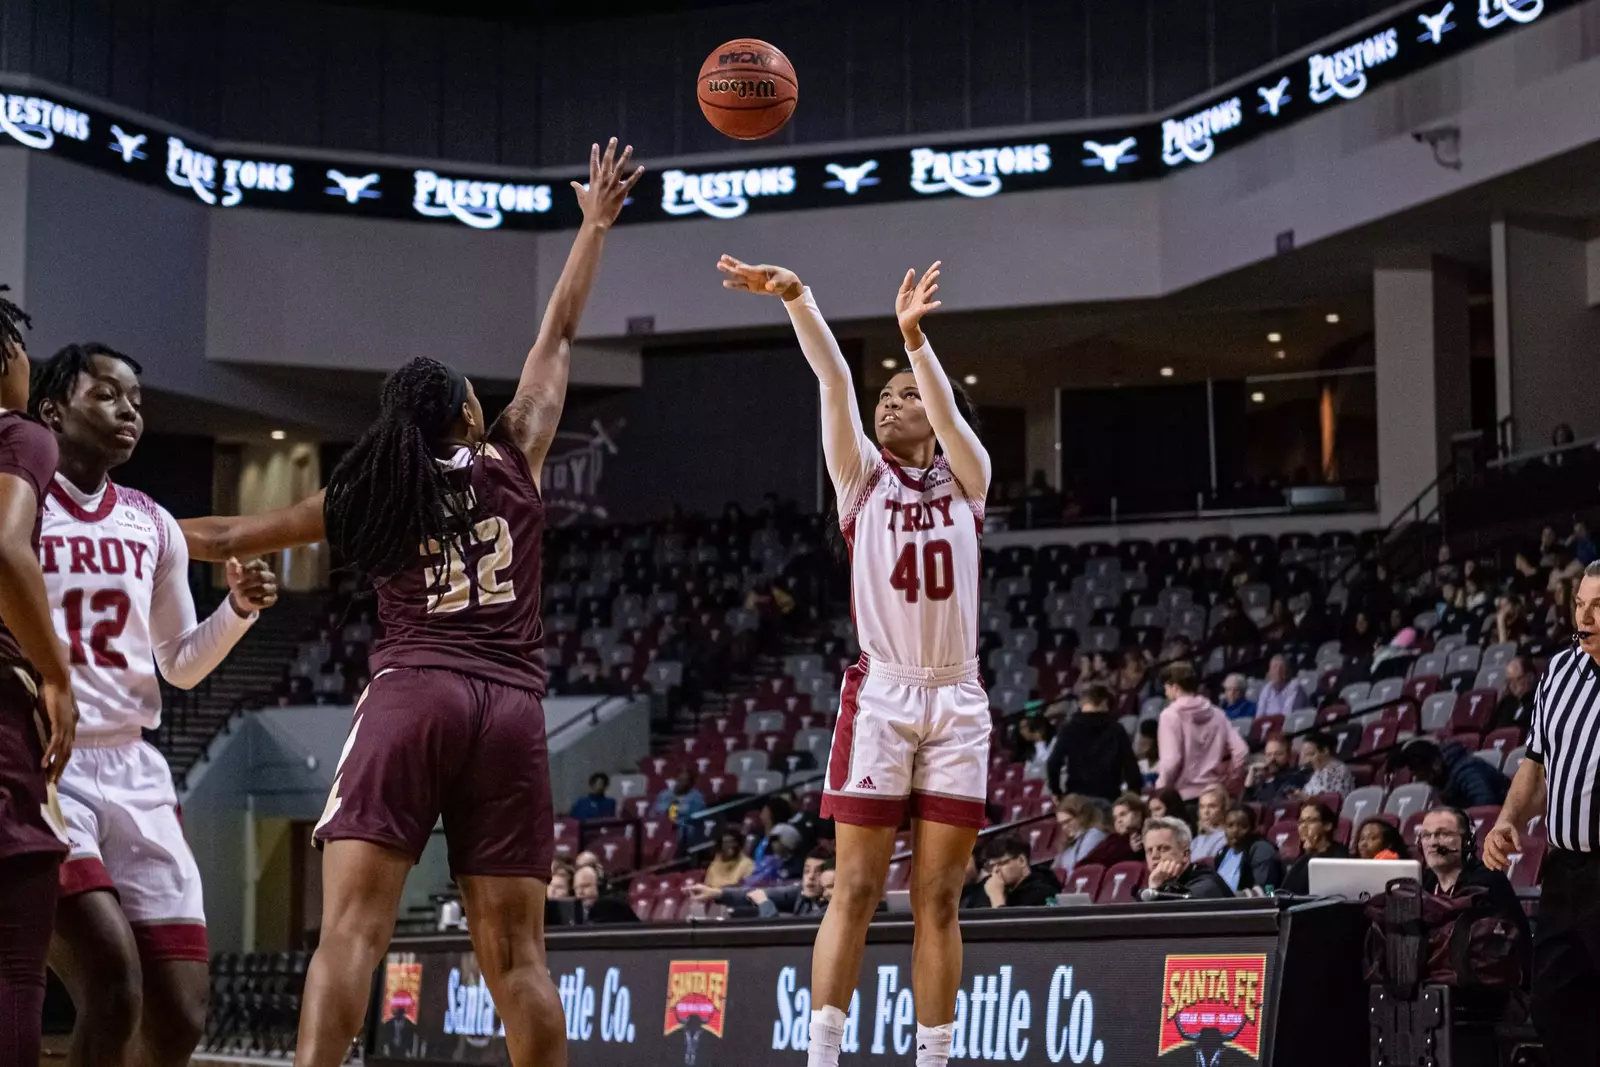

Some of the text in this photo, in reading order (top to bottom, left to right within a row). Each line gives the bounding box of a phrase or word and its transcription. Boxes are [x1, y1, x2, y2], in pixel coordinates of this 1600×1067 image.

[708, 79, 777, 99] Wilson
[1308, 27, 1399, 103] PRESTONS
[1162, 97, 1243, 166] PRESTONS
[413, 170, 553, 229] PRESTONS
[661, 165, 797, 219] PRESTONS
[911, 143, 1051, 197] PRESTONS
[884, 495, 954, 532] TROY
[40, 536, 148, 581] TROY
[418, 515, 517, 615] 32
[889, 539, 954, 603] 40
[62, 587, 131, 670] 12
[600, 966, 636, 1043] Co.
[771, 964, 1105, 1065] Saa Fe attle Co.
[1166, 968, 1259, 1025] SANTA FE
